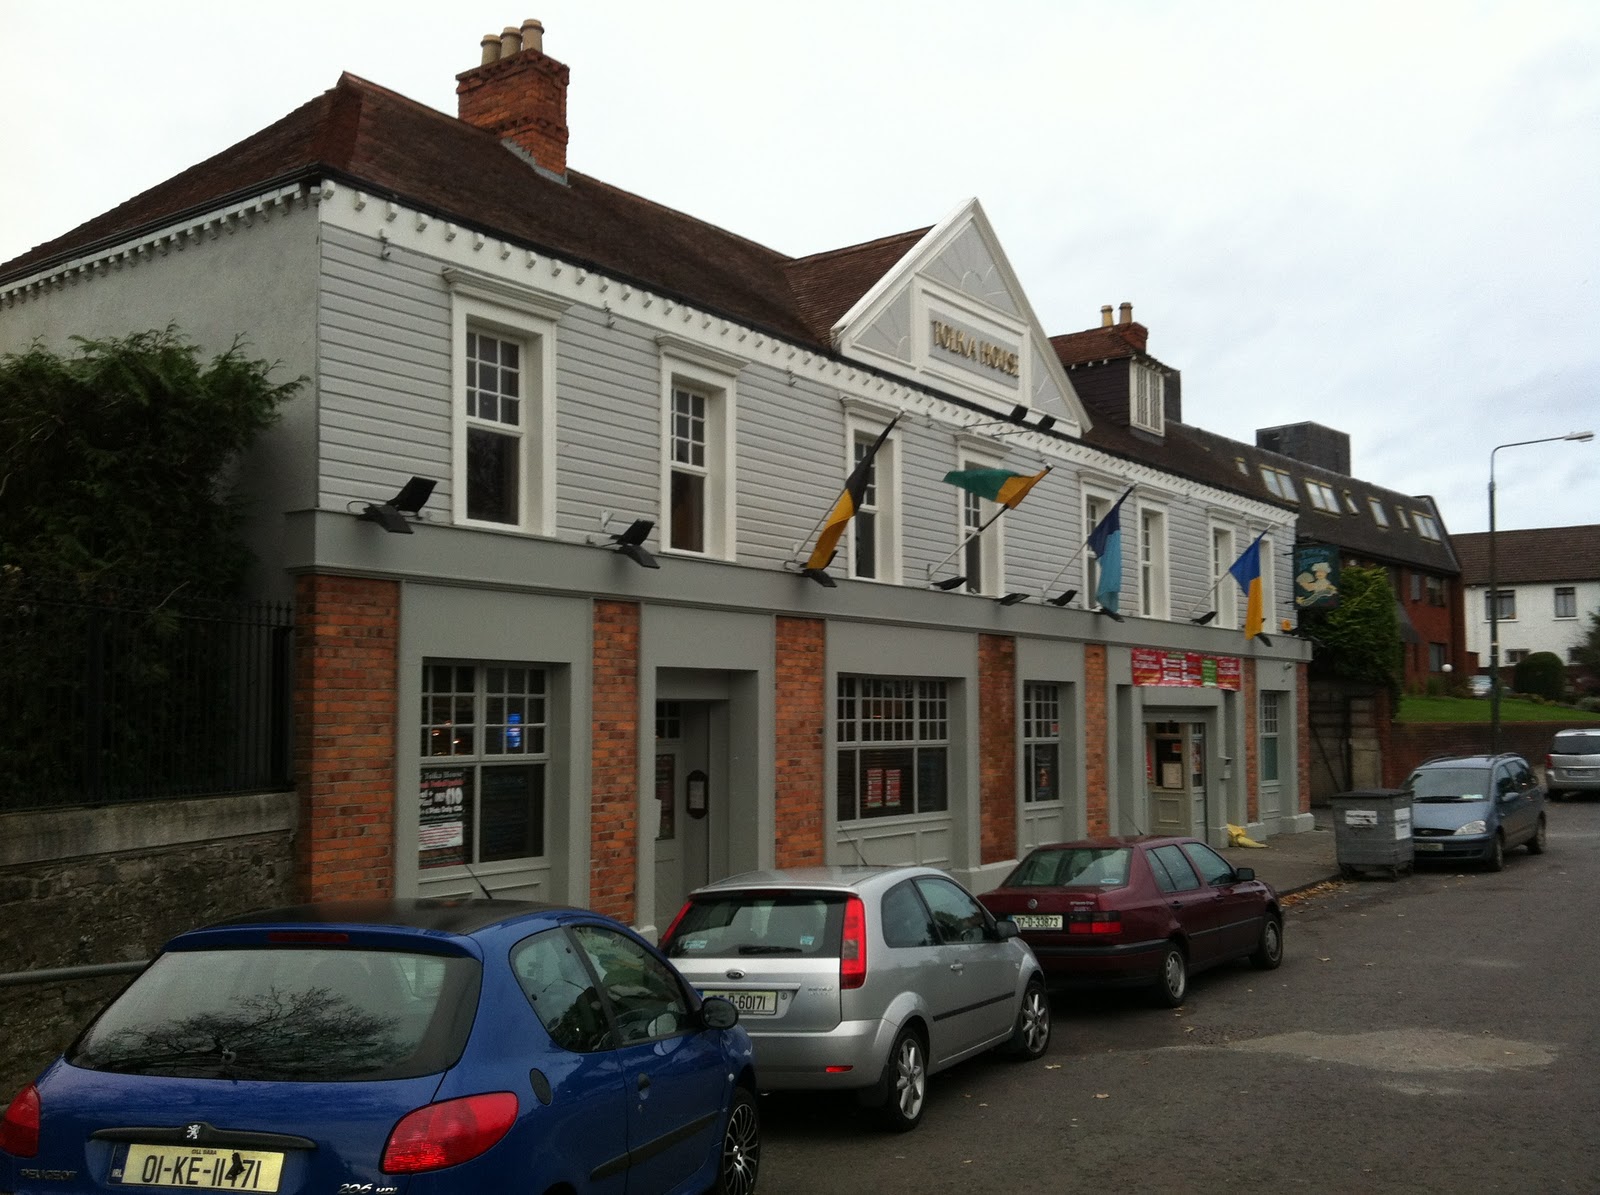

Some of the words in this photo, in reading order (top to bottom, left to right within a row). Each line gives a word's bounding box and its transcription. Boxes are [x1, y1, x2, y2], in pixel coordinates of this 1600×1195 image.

[979, 340, 1020, 379] HOUSE
[20, 1168, 78, 1180] PEUGEOT
[338, 1183, 373, 1194] 206
